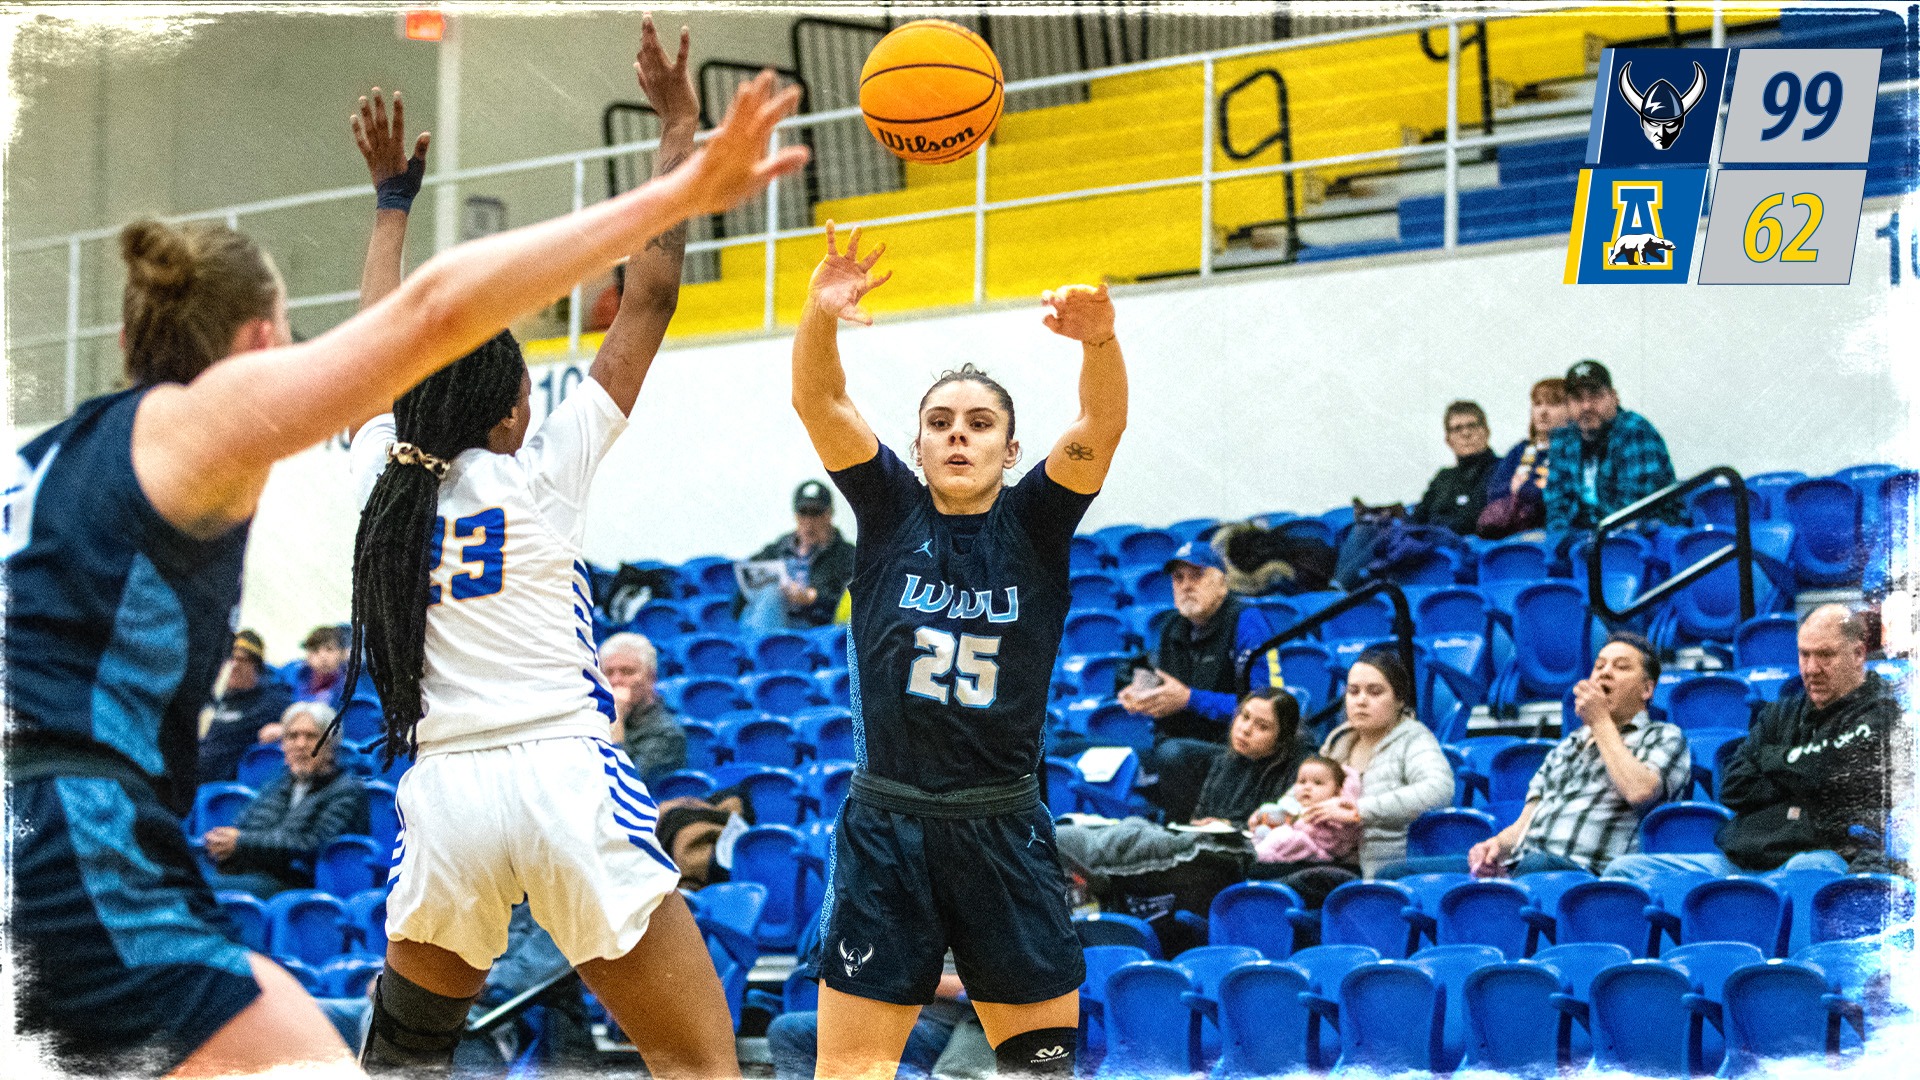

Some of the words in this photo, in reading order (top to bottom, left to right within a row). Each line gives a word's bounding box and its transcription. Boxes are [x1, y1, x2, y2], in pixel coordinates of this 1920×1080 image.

[877, 126, 976, 153] Wilson
[1875, 212, 1920, 285] 1
[428, 506, 508, 608] 3
[899, 573, 1019, 623] WWU
[906, 626, 1002, 709] 25
